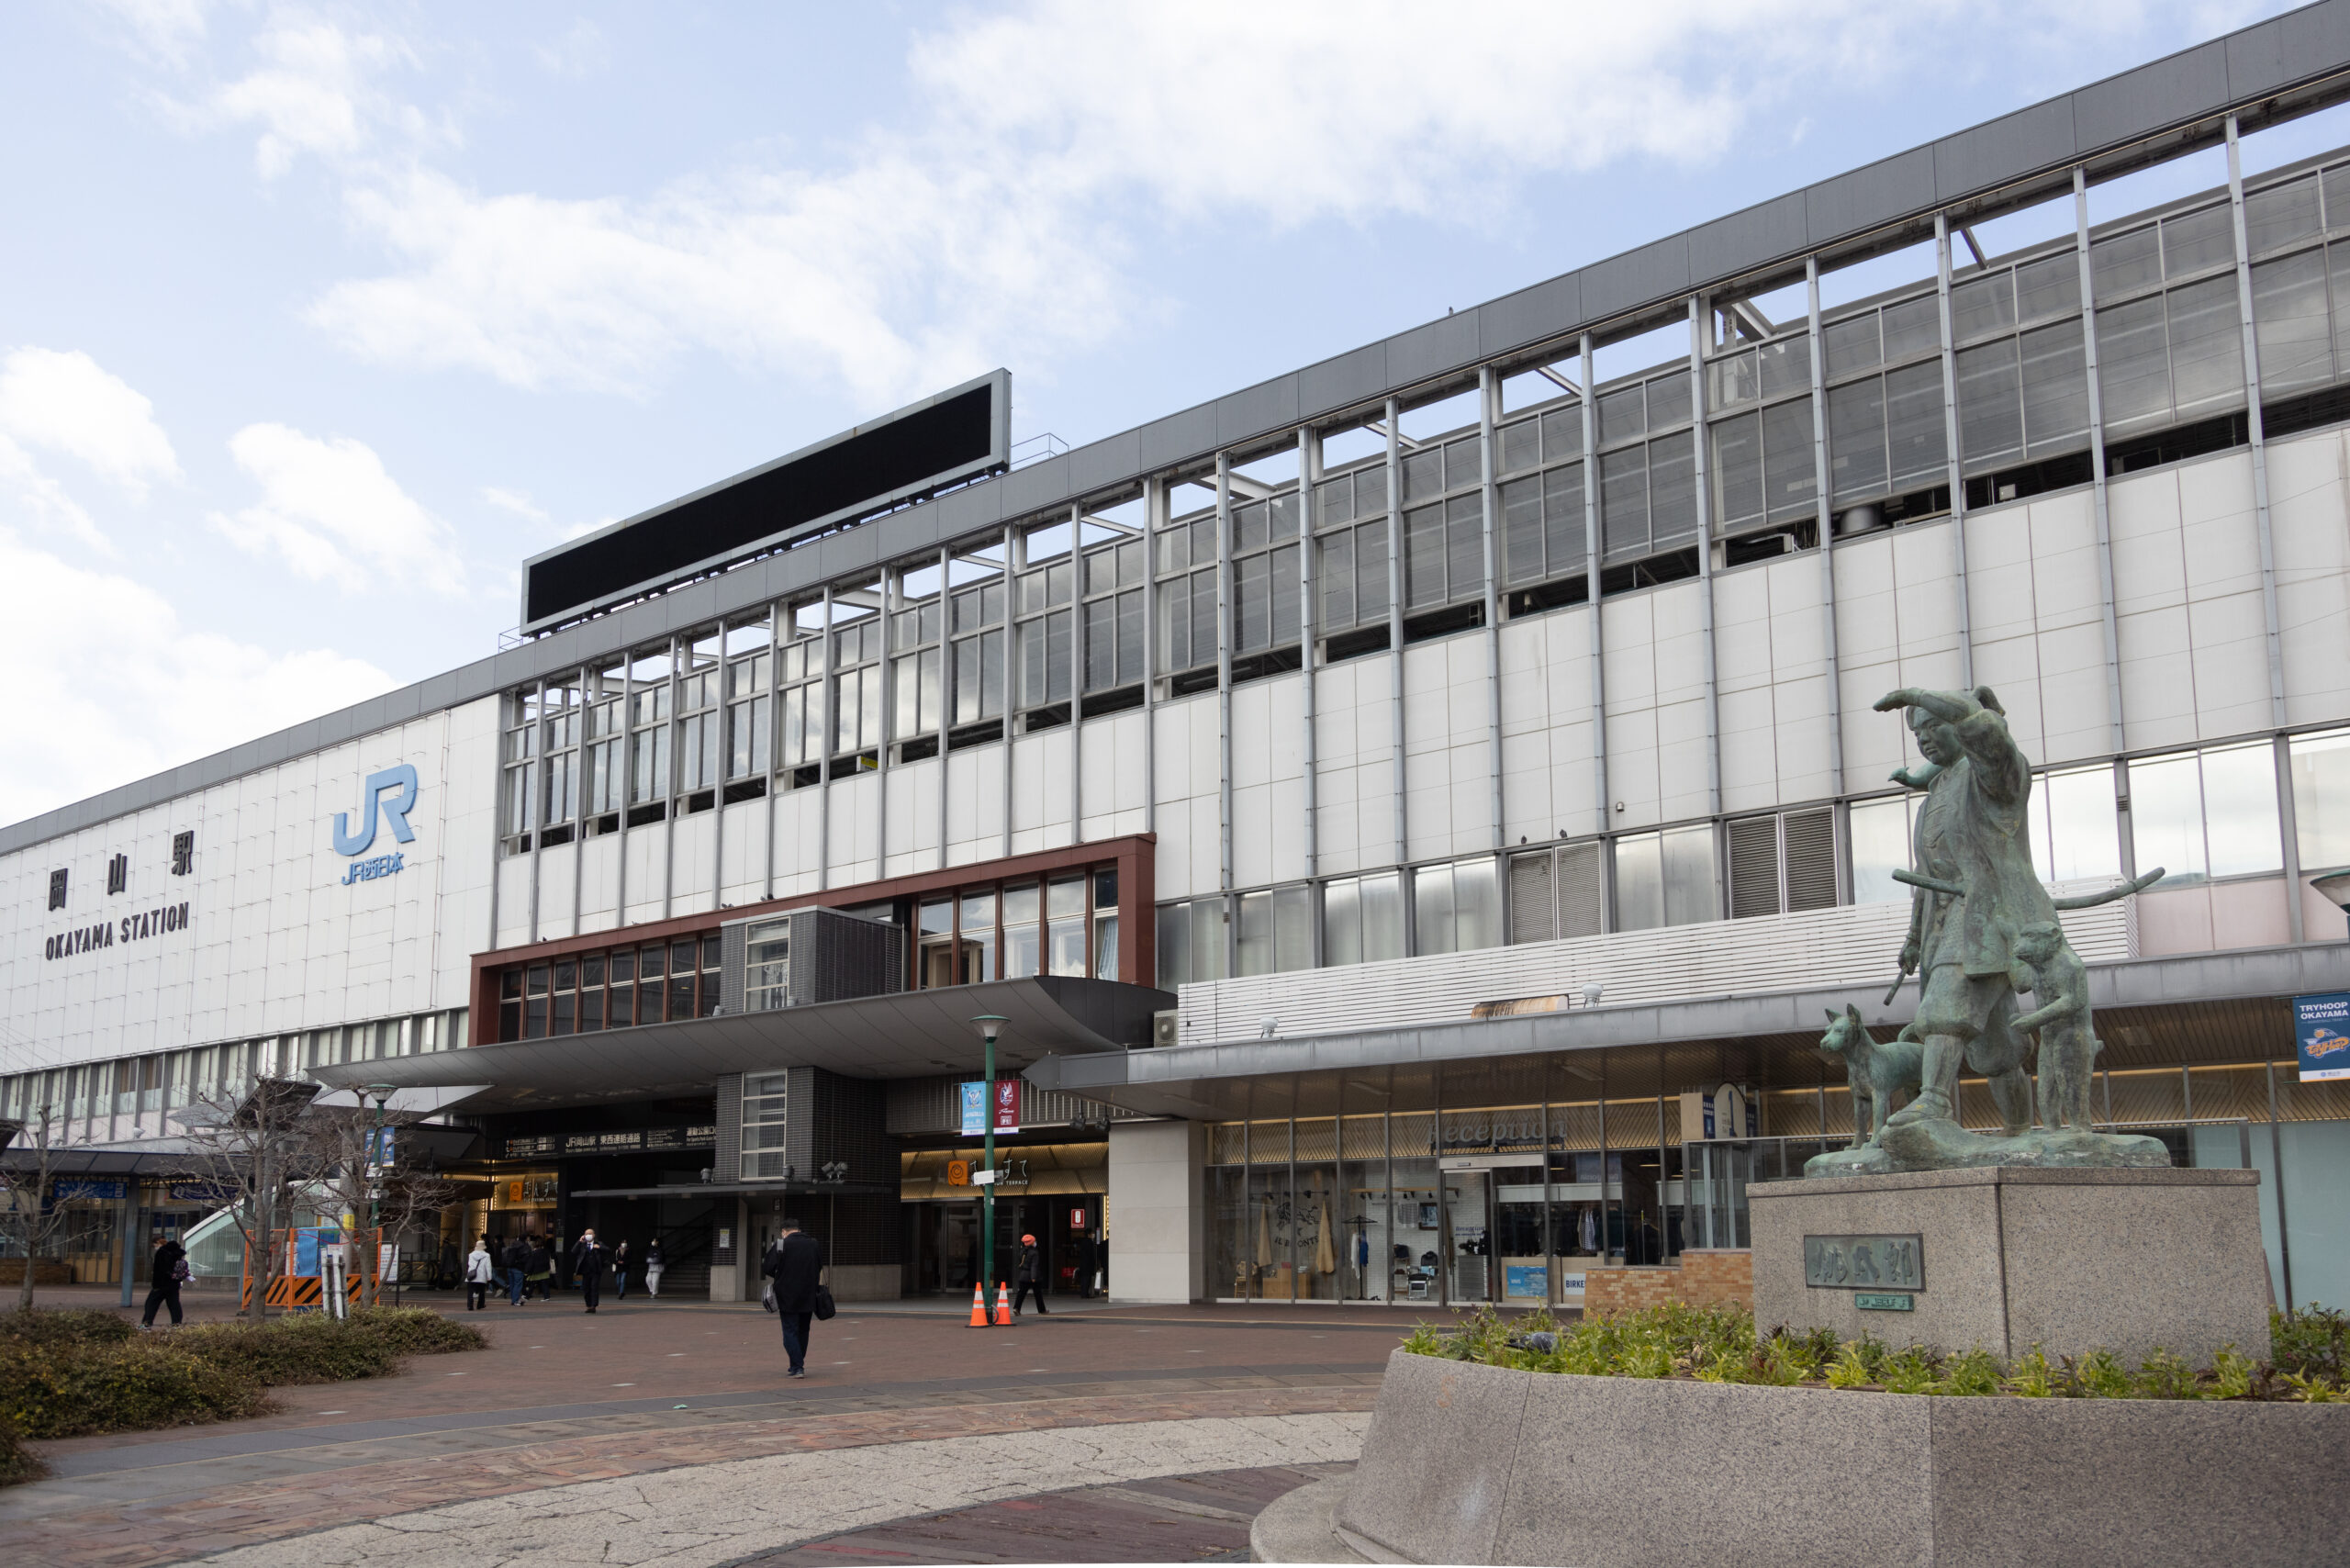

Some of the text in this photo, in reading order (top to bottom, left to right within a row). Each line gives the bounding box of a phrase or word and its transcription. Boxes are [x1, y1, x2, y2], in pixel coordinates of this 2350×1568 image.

[332, 763, 419, 857] JR
[48, 830, 195, 912] 岡山駅
[341, 851, 405, 886] JR西日本
[45, 901, 189, 961] OKAYAMA STATION
[2299, 1002, 2349, 1013] TRYHOOP
[2300, 1009, 2350, 1020] OKAYAMA
[565, 1136, 597, 1148] JR岡山駅
[1565, 1280, 1586, 1288] BIRKE
